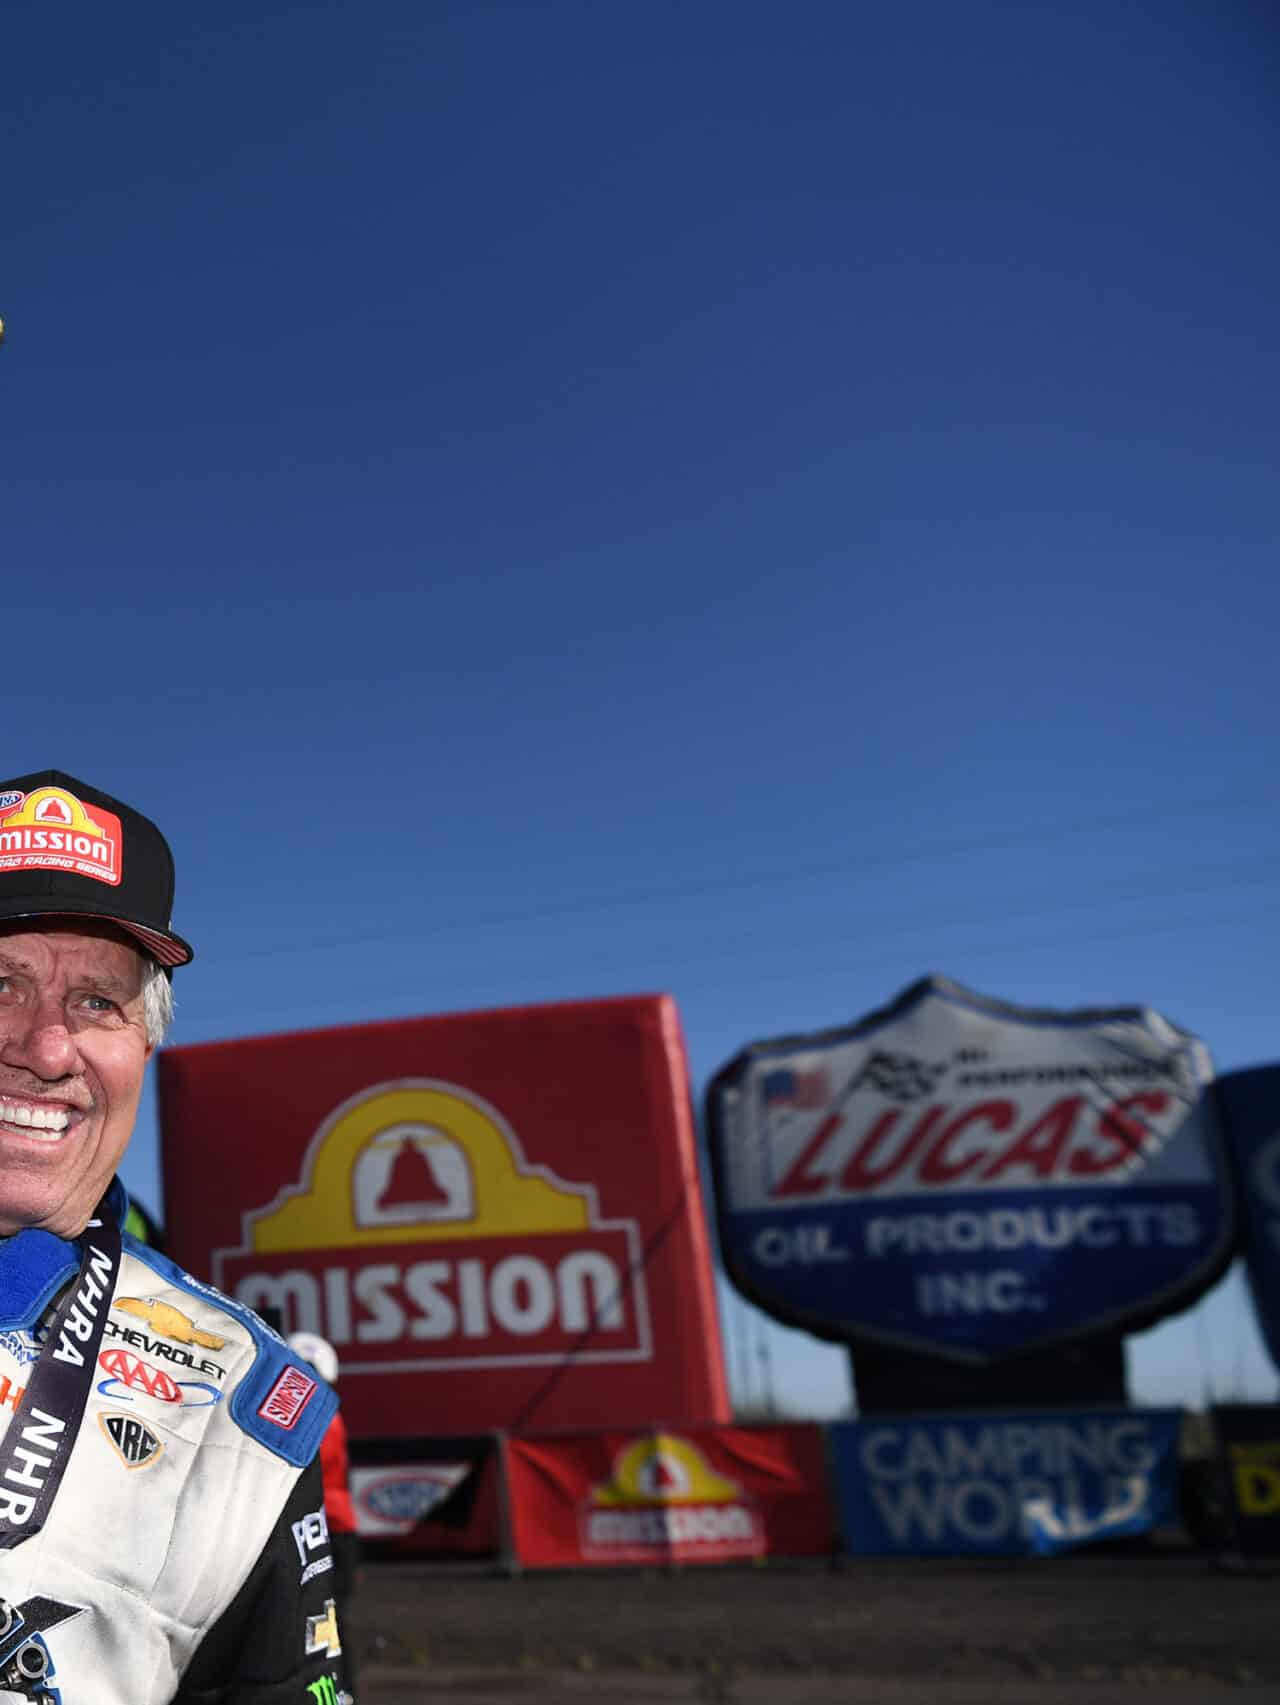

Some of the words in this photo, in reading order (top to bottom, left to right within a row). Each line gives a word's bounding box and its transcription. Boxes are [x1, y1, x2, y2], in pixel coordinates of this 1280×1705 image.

[24, 856, 74, 868] RACING
[769, 1091, 1172, 1199] LUCAS
[755, 1224, 849, 1266] OIL
[867, 1204, 1201, 1258] PRODUCTS
[53, 1245, 113, 1368] NHRA
[236, 1250, 623, 1351] MISSION
[917, 1272, 1046, 1314] INC.
[103, 1320, 227, 1381] CHEVROLET
[108, 1351, 179, 1402] AAA
[265, 1370, 310, 1425] SIMPSON
[861, 1421, 1156, 1479] CAMPING
